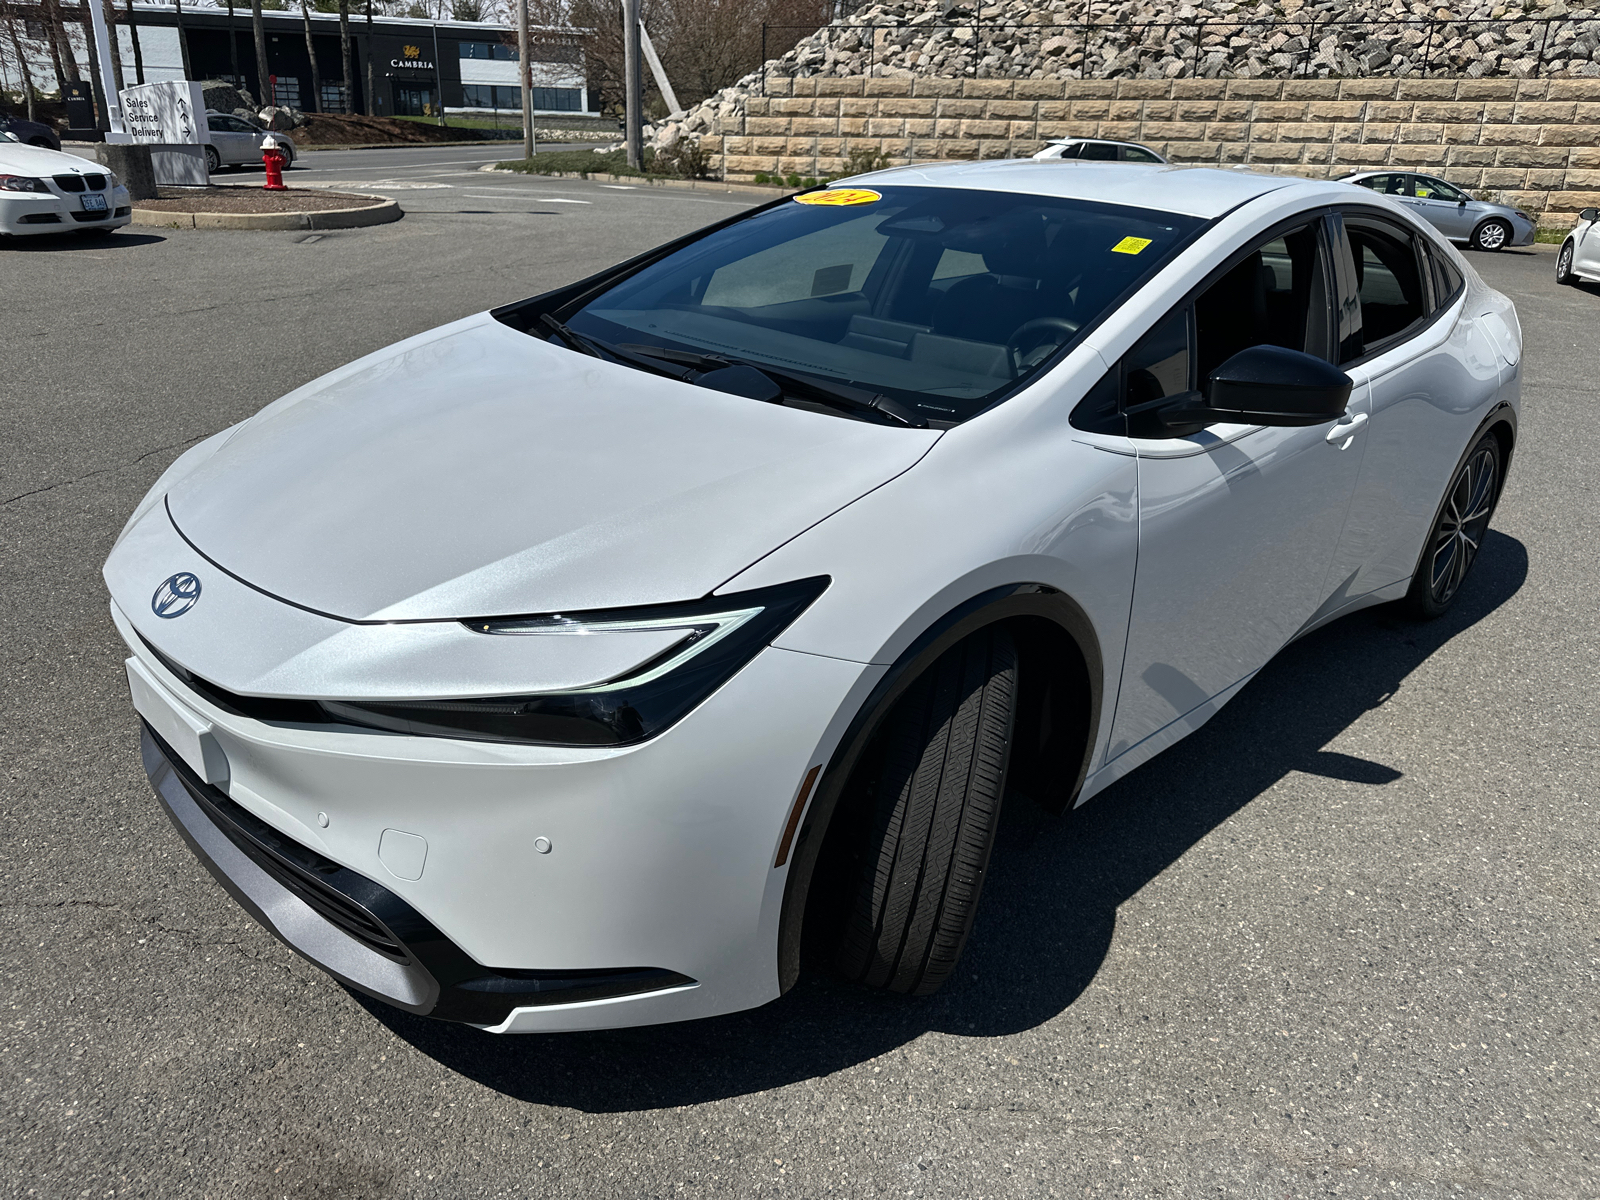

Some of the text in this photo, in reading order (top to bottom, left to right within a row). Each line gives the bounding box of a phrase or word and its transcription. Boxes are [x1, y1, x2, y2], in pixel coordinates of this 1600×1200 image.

[390, 59, 434, 69] CAMBRIA
[126, 97, 148, 108] Sales
[128, 112, 159, 123] Service
[131, 127, 164, 138] Delivery
